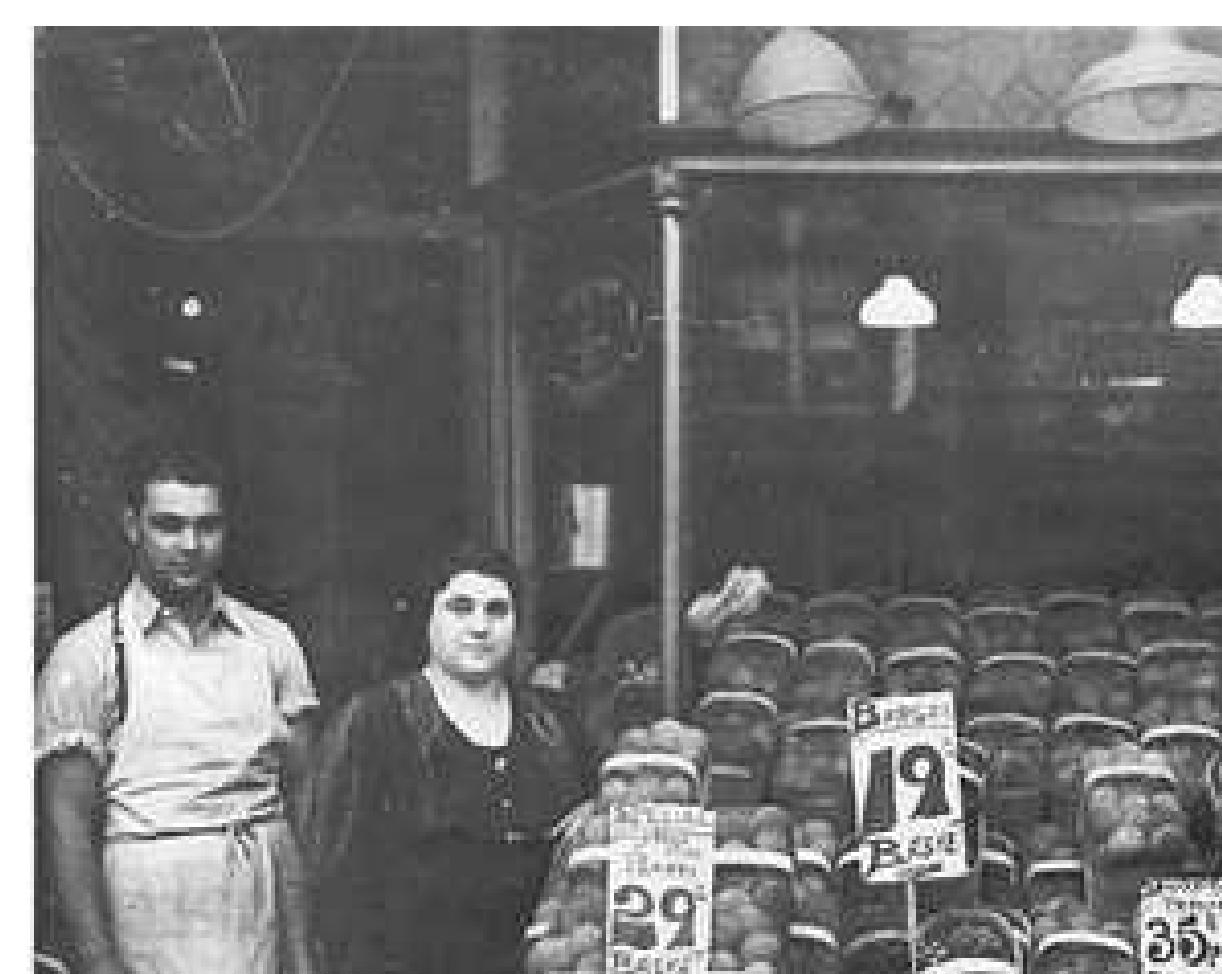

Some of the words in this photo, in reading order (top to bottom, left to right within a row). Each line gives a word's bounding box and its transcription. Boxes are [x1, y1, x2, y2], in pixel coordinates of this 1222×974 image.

[863, 744, 951, 834] 19
[612, 883, 697, 950] 29
[1146, 912, 1207, 967] 35
